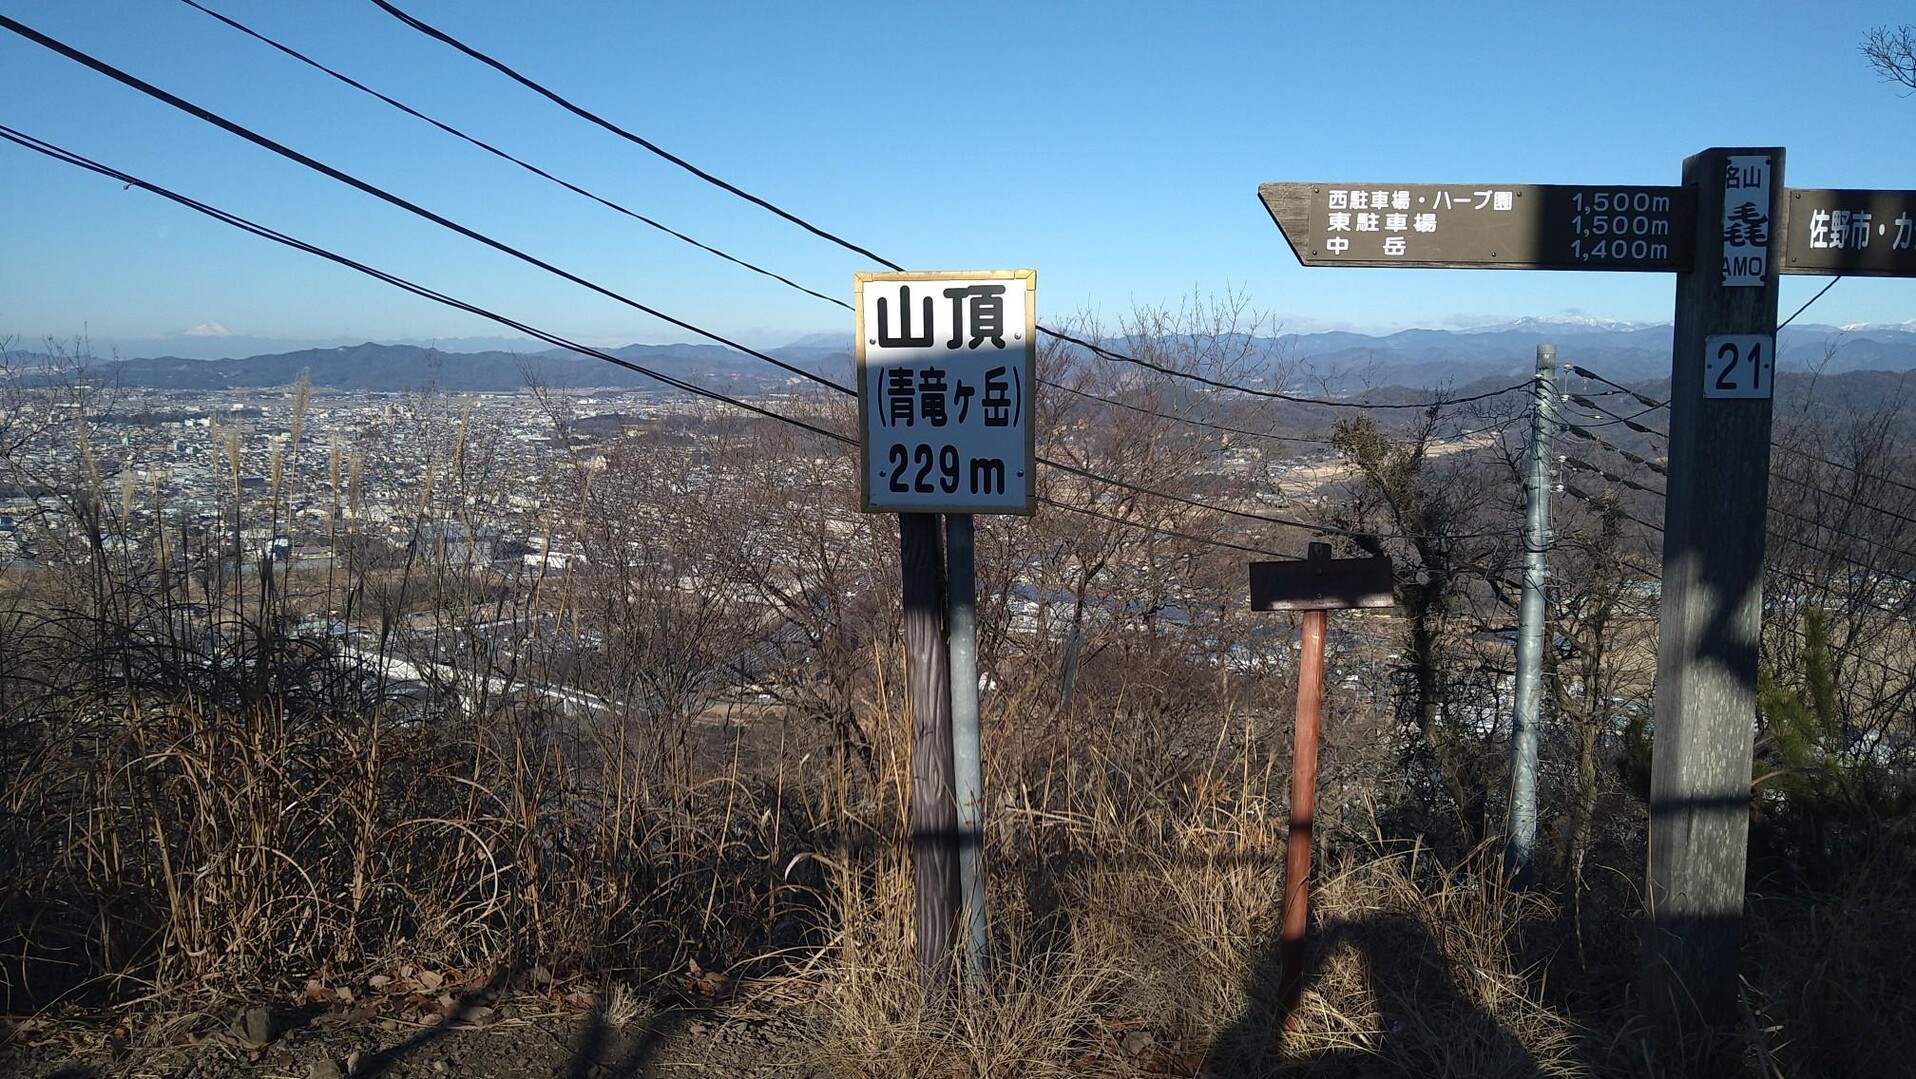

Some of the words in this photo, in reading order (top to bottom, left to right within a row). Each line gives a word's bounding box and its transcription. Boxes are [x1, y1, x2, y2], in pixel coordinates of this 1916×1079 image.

[1572, 192, 1670, 215] 1,500m
[1327, 211, 1438, 233] 東駐車場
[1571, 215, 1669, 238] 1,500m
[1809, 209, 1916, 250] 佐野市・カ
[1570, 239, 1668, 262] 1,400m
[877, 284, 1007, 350] 山頂
[1715, 342, 1761, 391] 21
